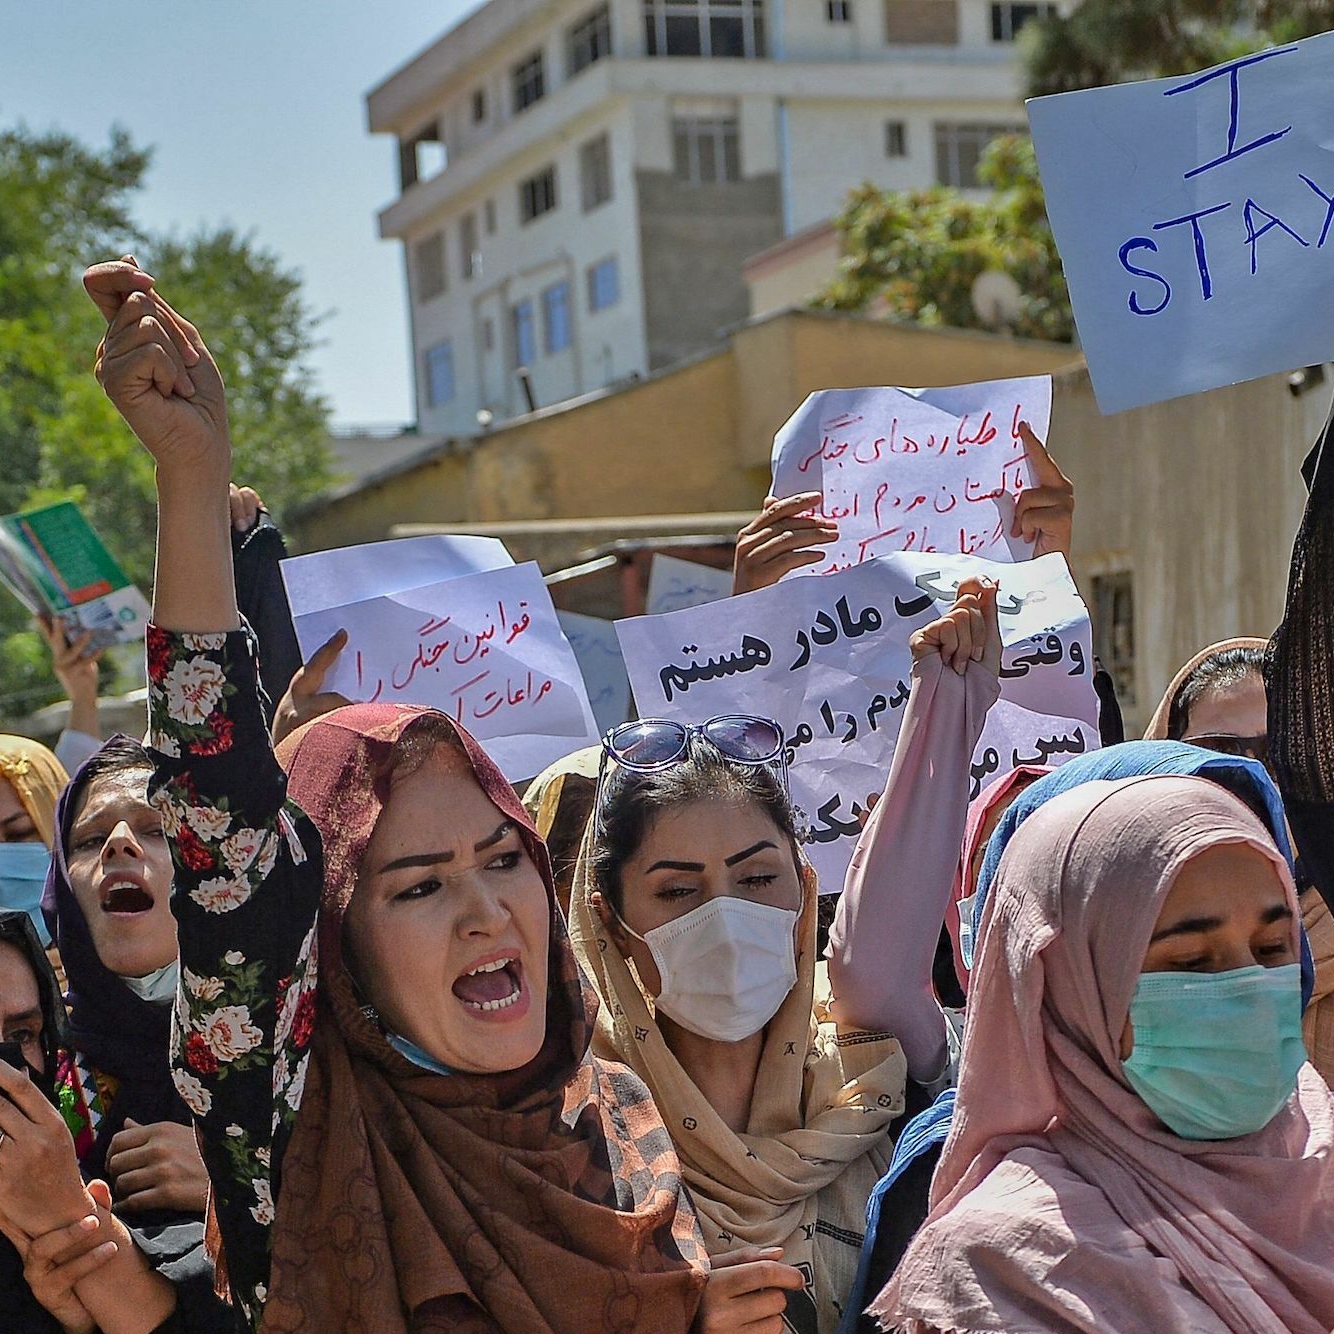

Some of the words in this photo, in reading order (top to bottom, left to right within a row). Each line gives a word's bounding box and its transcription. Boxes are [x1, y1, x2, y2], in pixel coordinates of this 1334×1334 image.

[854, 418, 919, 464] های
[874, 482, 926, 529] مردم
[454, 600, 532, 664] قوانین
[789, 594, 884, 673] مادر
[356, 651, 383, 704] را
[659, 634, 772, 702] هستم
[473, 671, 553, 719] مراعات
[820, 700, 858, 744] را
